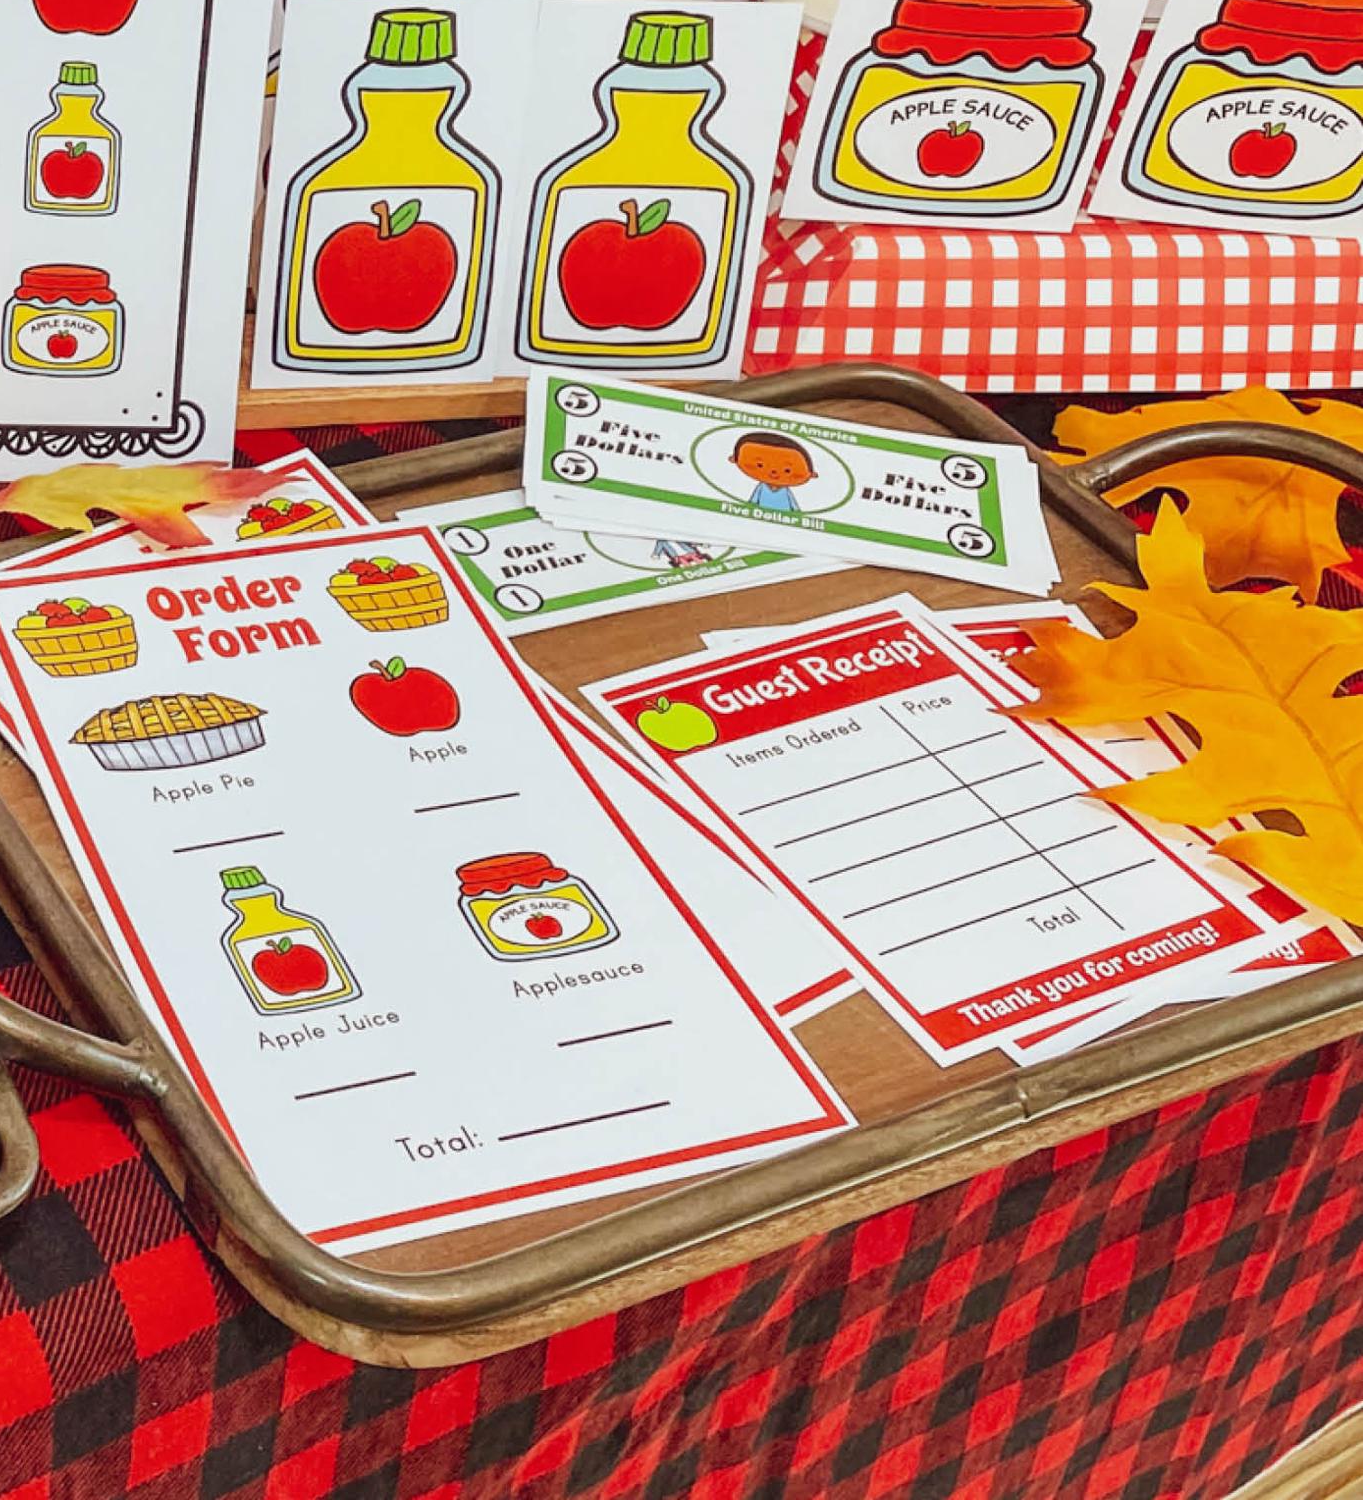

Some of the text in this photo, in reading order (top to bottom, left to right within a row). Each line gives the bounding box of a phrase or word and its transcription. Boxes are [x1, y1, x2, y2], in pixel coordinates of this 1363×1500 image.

[890, 99, 1034, 131] APPLE SAUCE
[1206, 99, 1348, 135] APPLE SAUCE
[564, 391, 590, 409] 5
[600, 420, 661, 441] Five
[684, 403, 858, 443] United States of America
[575, 434, 684, 464] Dollars
[560, 457, 586, 476] 5
[952, 462, 976, 481] 5
[885, 473, 946, 494] Five
[721, 502, 825, 530] Five Dollar Bill
[861, 487, 972, 518] Dollars
[457, 532, 475, 548] 1
[503, 542, 555, 559] One
[958, 531, 983, 550] 5
[500, 552, 586, 579] Dollar
[683, 565, 723, 580] Dollar
[146, 573, 302, 621] Order
[510, 590, 528, 607] 1
[173, 617, 321, 664] Form
[703, 627, 936, 715] Guest Receipt
[902, 693, 953, 717] Price
[408, 740, 468, 762] Apple
[726, 718, 862, 769] Items Ordered
[152, 773, 255, 803] Apple Pie
[1026, 906, 1082, 933] Total
[513, 960, 644, 999] Applesauce
[957, 986, 1041, 1026] Thank
[1038, 969, 1089, 1002] you
[1083, 956, 1125, 981] for
[1125, 919, 1221, 968] coming!
[258, 1009, 400, 1052] Apple Juice
[395, 1127, 484, 1164] Total:
